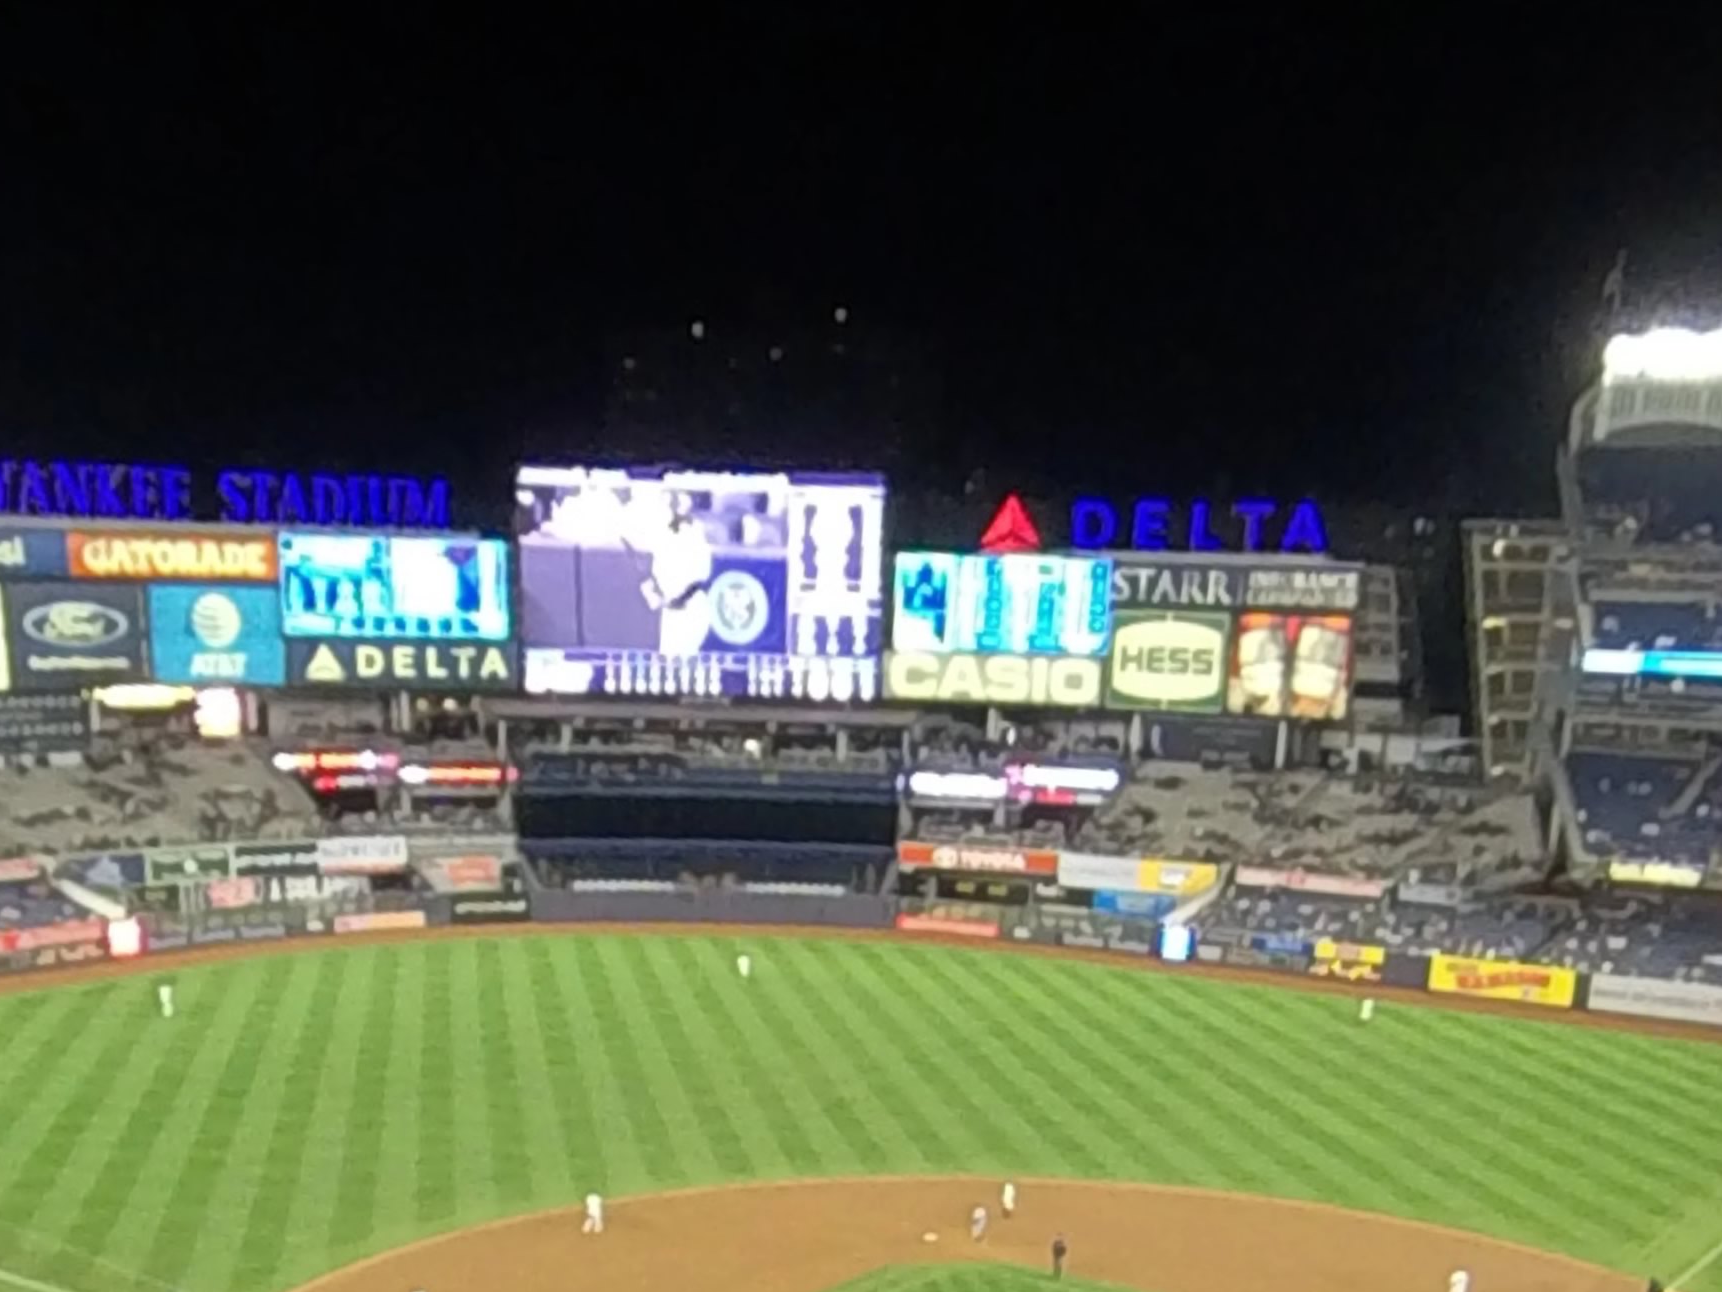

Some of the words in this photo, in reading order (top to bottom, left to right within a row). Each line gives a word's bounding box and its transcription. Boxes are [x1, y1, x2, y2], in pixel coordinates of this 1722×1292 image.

[217, 466, 450, 528] STADIUM
[1070, 496, 1328, 553] DELTA
[82, 537, 268, 578] GATORADE
[1114, 566, 1232, 606] STARR
[355, 643, 509, 680] DELTA
[888, 653, 1102, 703] CASIO
[1119, 645, 1214, 677] HESS
